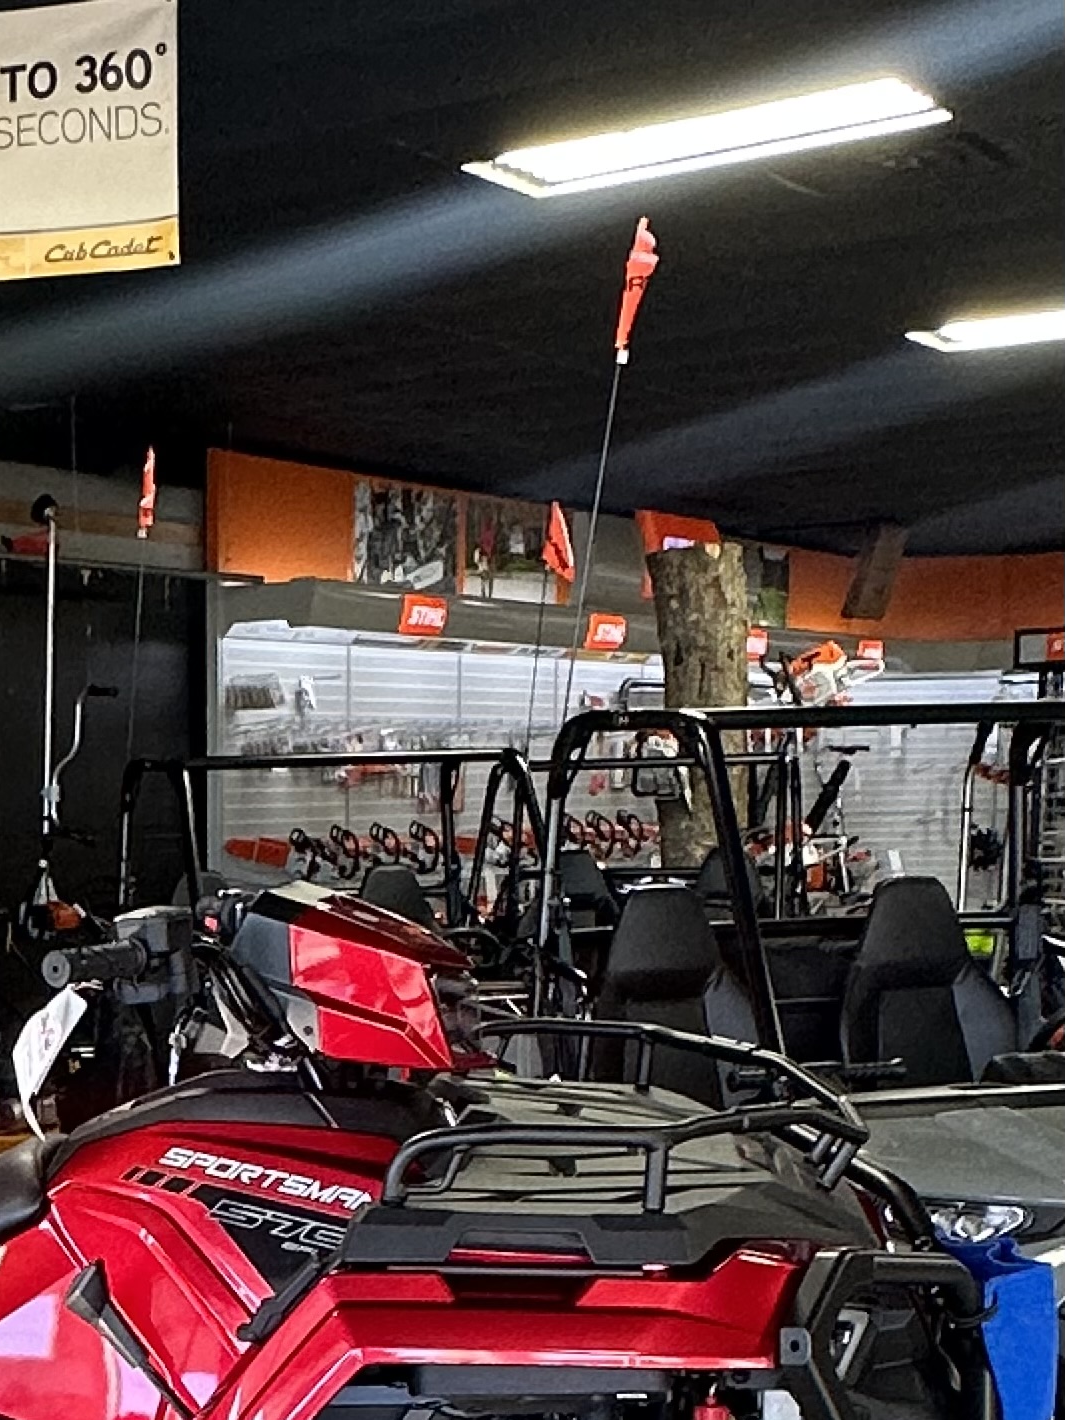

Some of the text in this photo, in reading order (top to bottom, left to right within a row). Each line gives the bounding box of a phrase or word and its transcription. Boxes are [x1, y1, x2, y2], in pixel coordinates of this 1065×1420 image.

[0, 61, 58, 103] TO
[75, 42, 168, 94] 360°
[89, 235, 164, 259] Cadet
